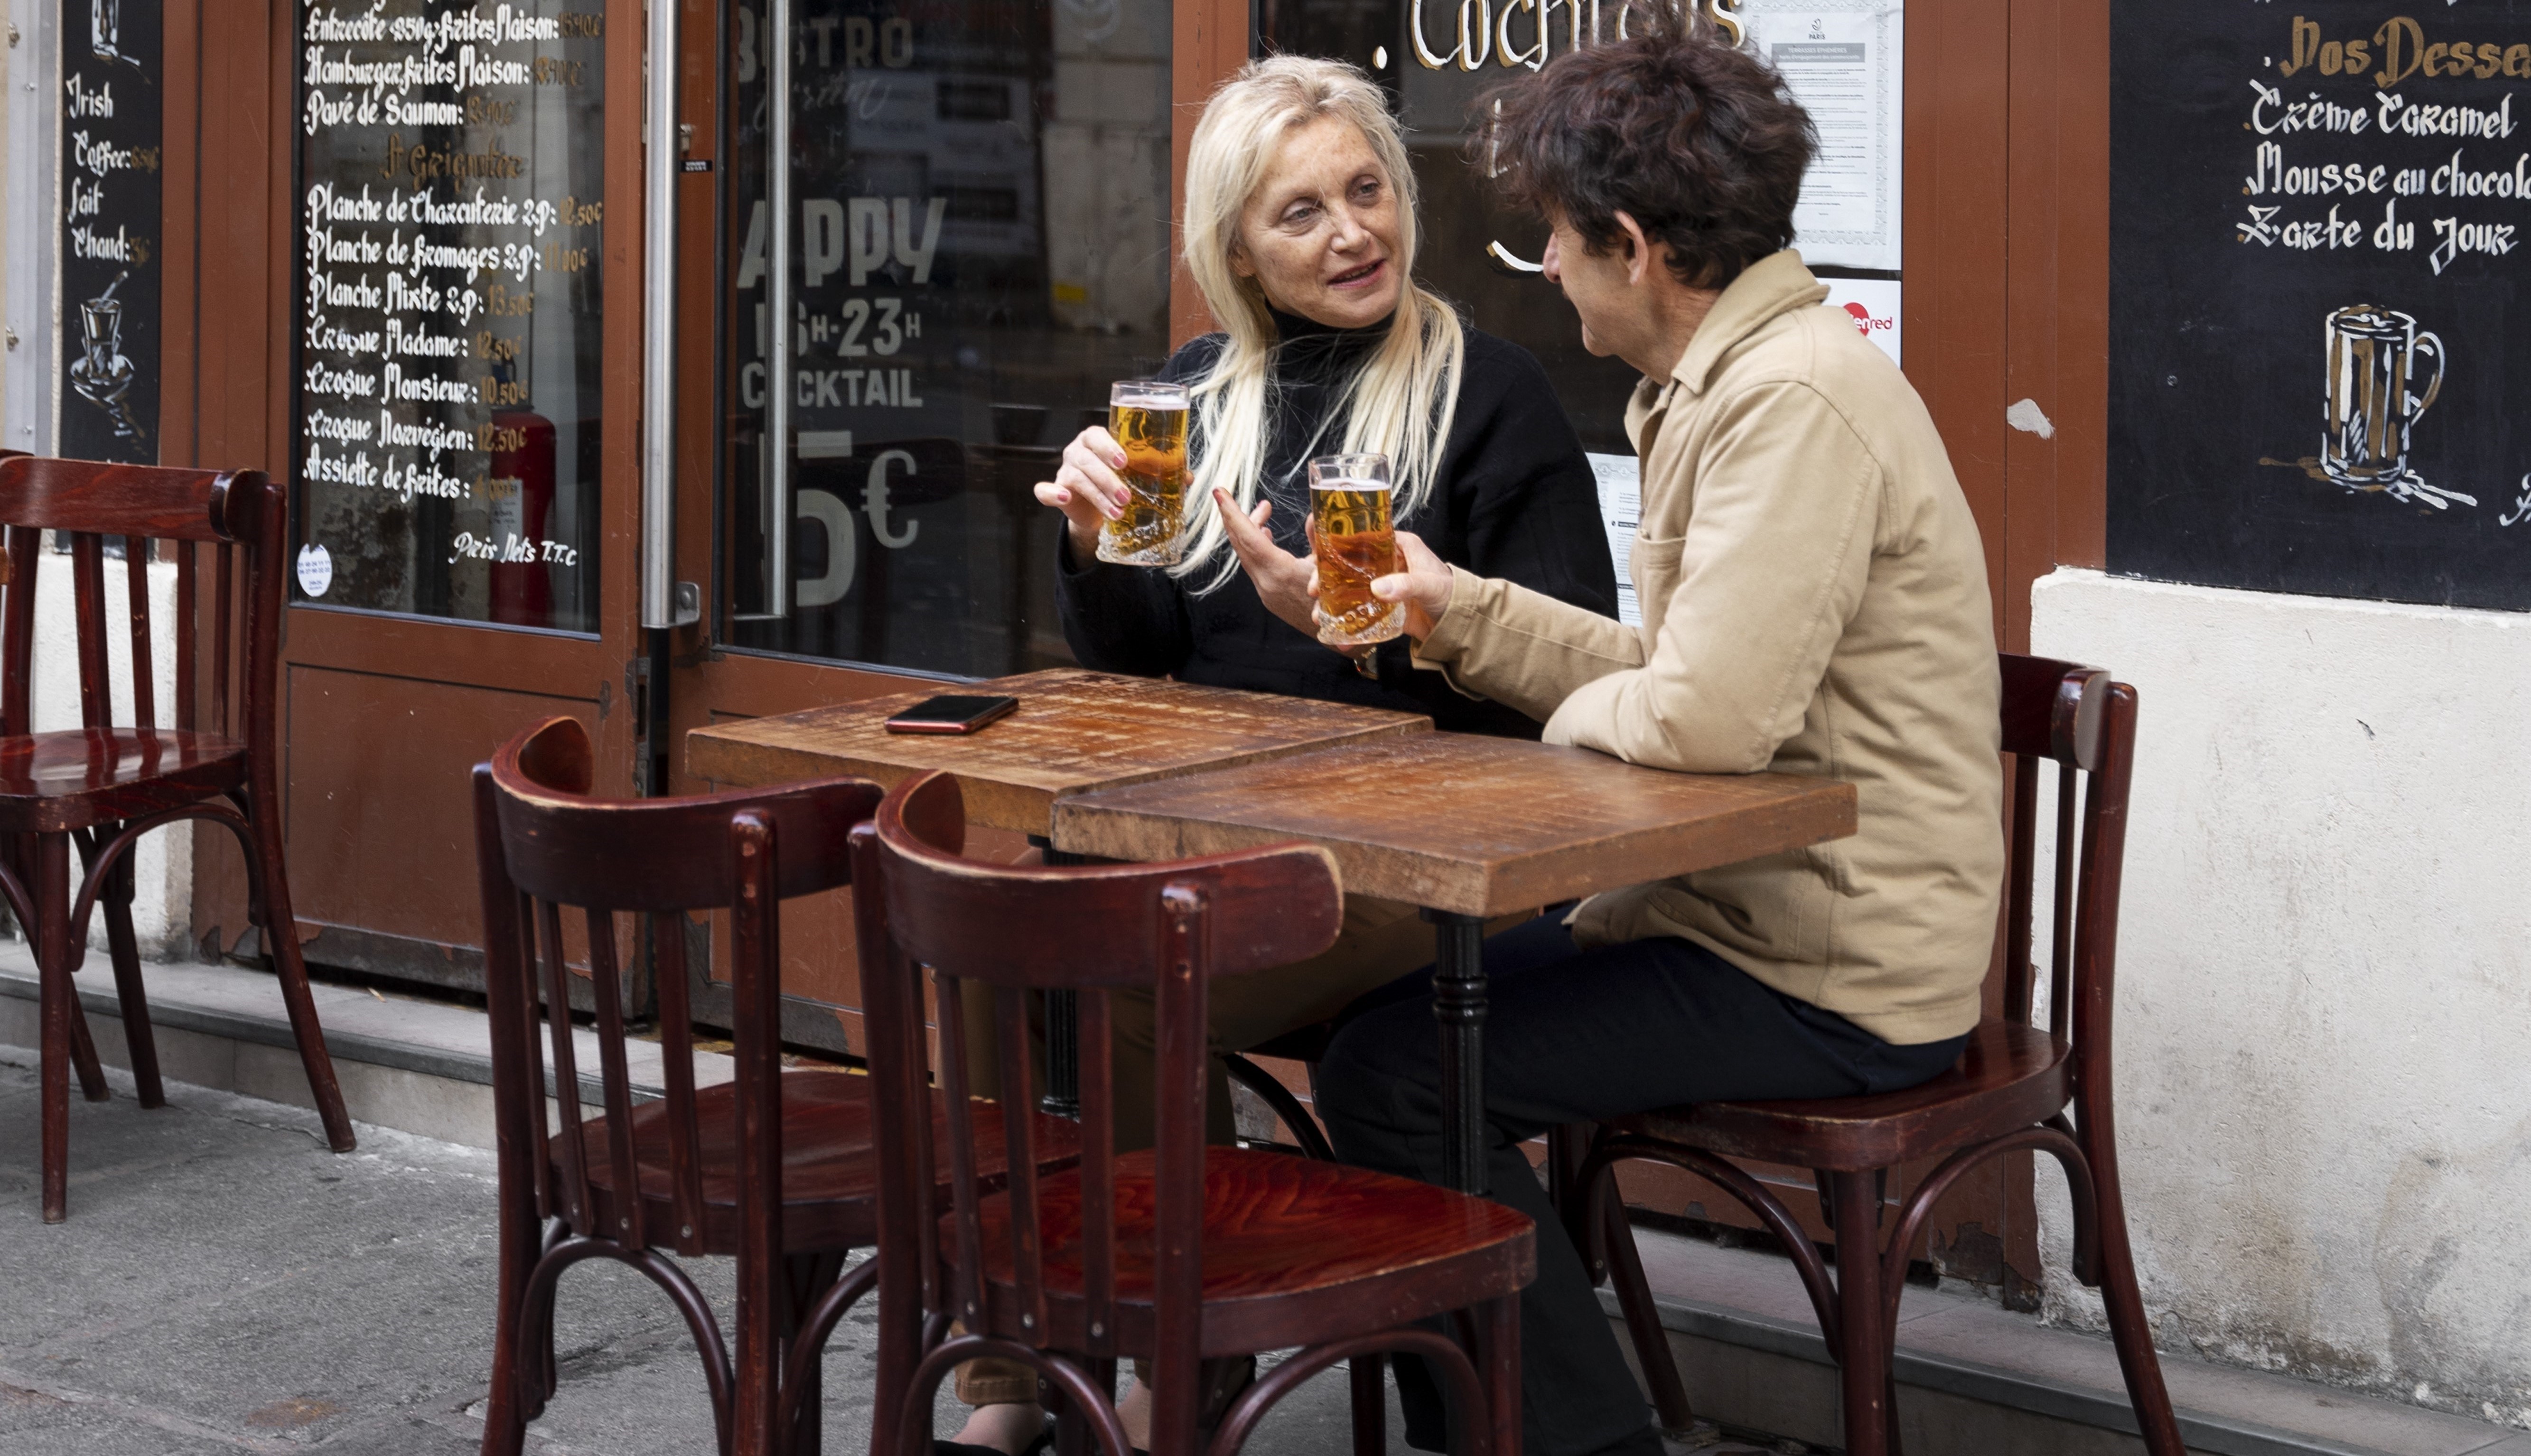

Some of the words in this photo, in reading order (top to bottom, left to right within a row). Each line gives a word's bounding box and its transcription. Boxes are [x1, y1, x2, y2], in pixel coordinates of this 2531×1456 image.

[307, 6, 386, 42] Entrecôte
[434, 5, 495, 53] frites
[492, 4, 560, 47] Maison:
[1410, 0, 1746, 73] Cocks
[2279, 16, 2372, 78] Nos
[2373, 16, 2531, 89] Desse
[399, 52, 456, 95] frites
[454, 45, 530, 93] Maison:
[66, 72, 113, 119] Irish
[306, 90, 354, 136] Pavé
[357, 88, 379, 127] de
[385, 93, 464, 126] Saumon:
[2250, 79, 2372, 135] Crème
[2376, 91, 2518, 139] Caramel
[73, 130, 131, 177] Coffee:
[2245, 140, 2388, 195] Mousse
[2393, 168, 2426, 196] au
[67, 177, 103, 224] Lait
[306, 181, 382, 234] Planche
[386, 187, 408, 223] de
[409, 187, 518, 225] Charcuterie
[71, 223, 131, 262] Chaud:
[307, 225, 382, 276] Planche
[386, 228, 408, 265] de
[409, 234, 500, 285] fromages
[2373, 198, 2415, 251] du
[2429, 217, 2519, 276] Jour
[307, 271, 382, 318] Planche
[383, 271, 442, 316] Mixte
[306, 315, 379, 357] Croque
[381, 318, 468, 361] Madame:
[1850, 313, 1893, 330] enred
[306, 361, 375, 401] Croque
[380, 362, 478, 405] Monsieur:
[742, 362, 923, 408] CCKTAIL
[306, 408, 372, 446] Croque
[377, 409, 474, 463] Norvégien:
[305, 442, 379, 487] Assiette
[383, 454, 402, 492] de
[400, 462, 470, 503] frites:
